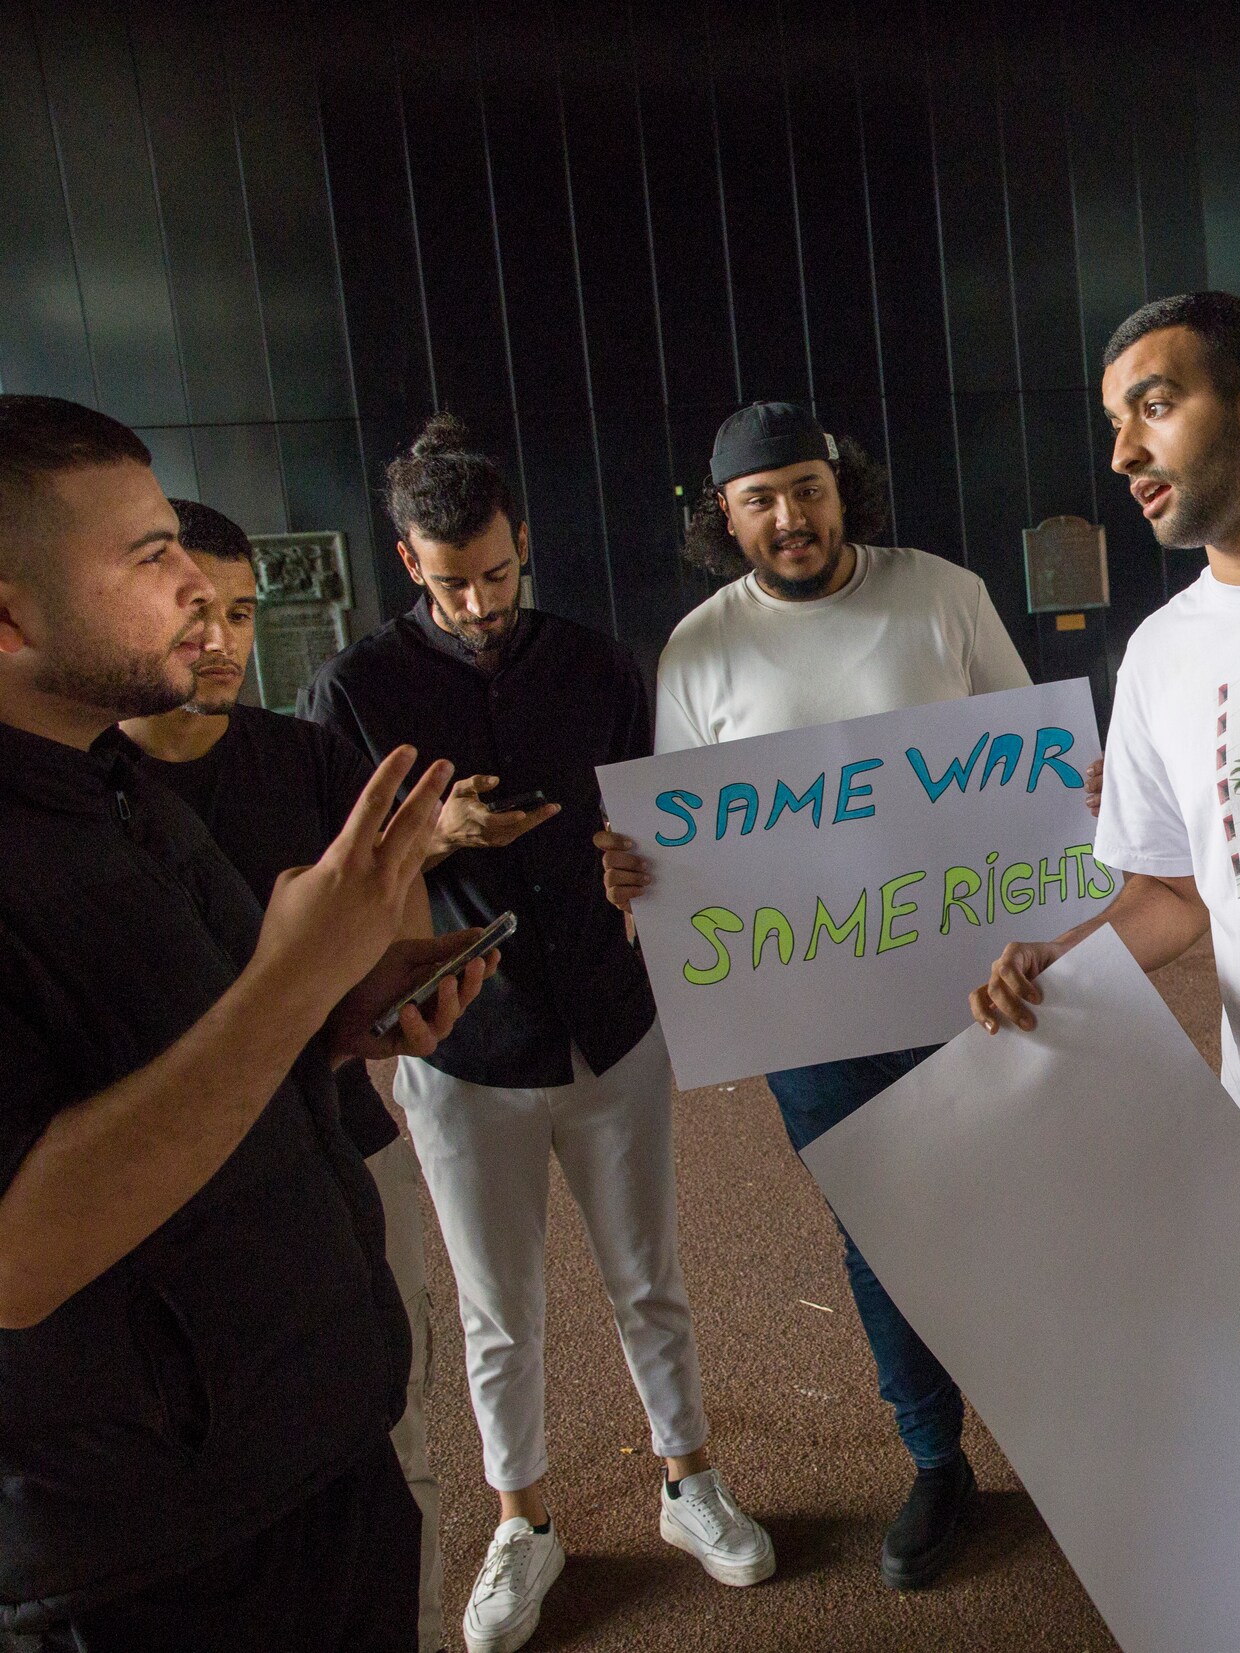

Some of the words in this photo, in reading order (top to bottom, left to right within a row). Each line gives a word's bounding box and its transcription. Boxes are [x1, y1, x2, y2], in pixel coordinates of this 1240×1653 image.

[654, 757, 884, 847] SAME
[904, 726, 1085, 803] WAR
[682, 869, 927, 986] SAME
